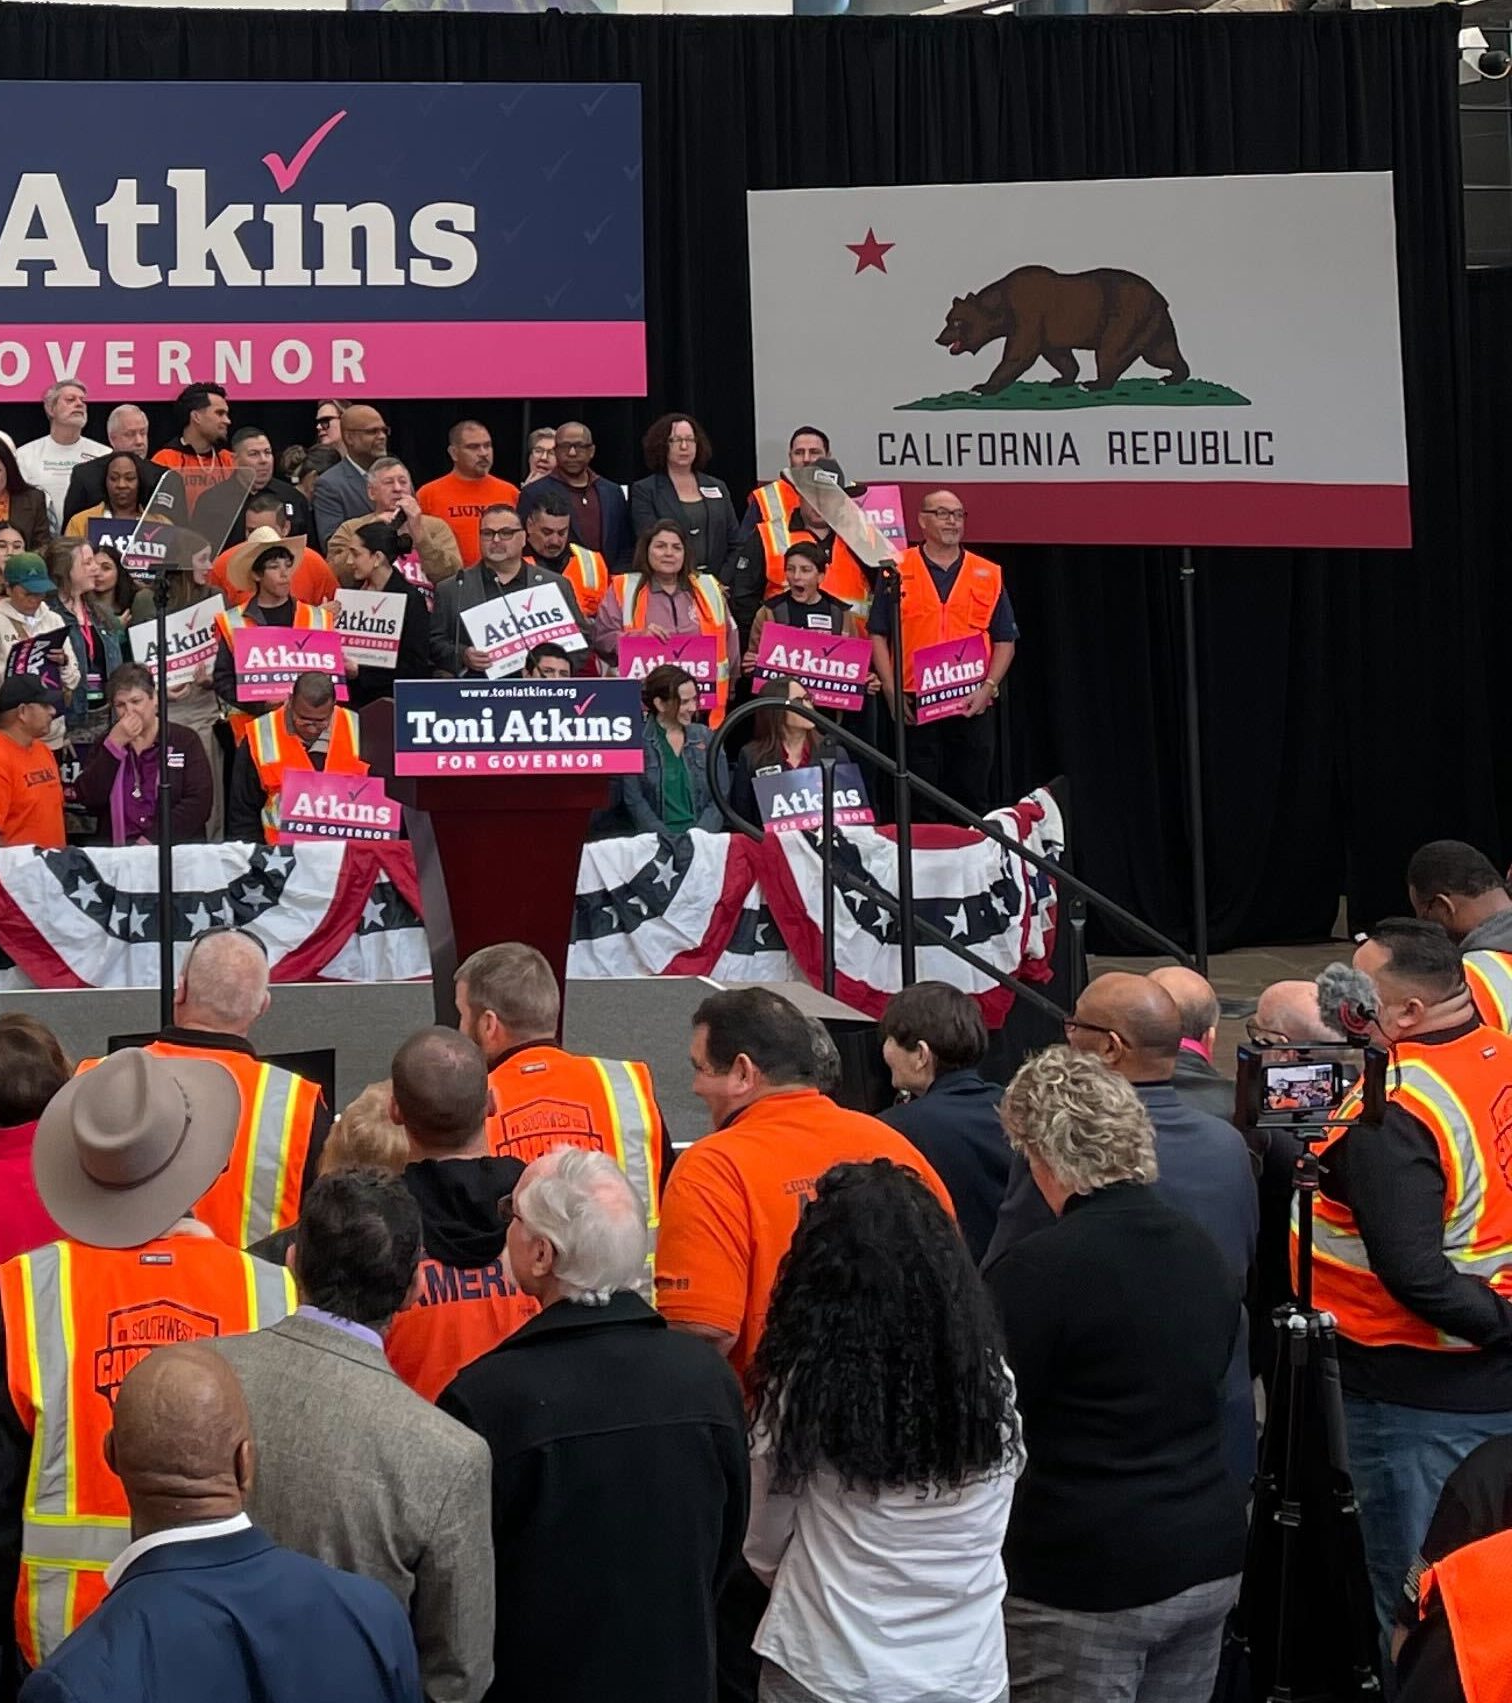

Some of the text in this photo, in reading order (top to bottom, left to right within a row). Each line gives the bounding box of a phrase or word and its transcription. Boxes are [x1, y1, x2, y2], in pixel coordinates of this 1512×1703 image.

[878, 430, 1275, 467] CALIFORNIA REPUBLIC
[336, 610, 397, 635] Atkins
[484, 607, 565, 647] Atkins
[244, 645, 336, 670] Atkins
[765, 644, 861, 680] Atkins
[243, 673, 268, 683] FOR
[800, 677, 858, 693] OVERNOR
[920, 659, 985, 692] Atkins
[460, 686, 578, 698] www.toniatkins.org
[921, 693, 937, 706] FOR
[406, 707, 633, 744] Toni Atkins
[437, 753, 604, 770] FOR GOVERNOR
[289, 792, 392, 826] Atkins
[770, 788, 862, 819] Atkns
[287, 822, 391, 841] FOR GOVERNOR
[132, 1315, 193, 1342] SOUTHWEST
